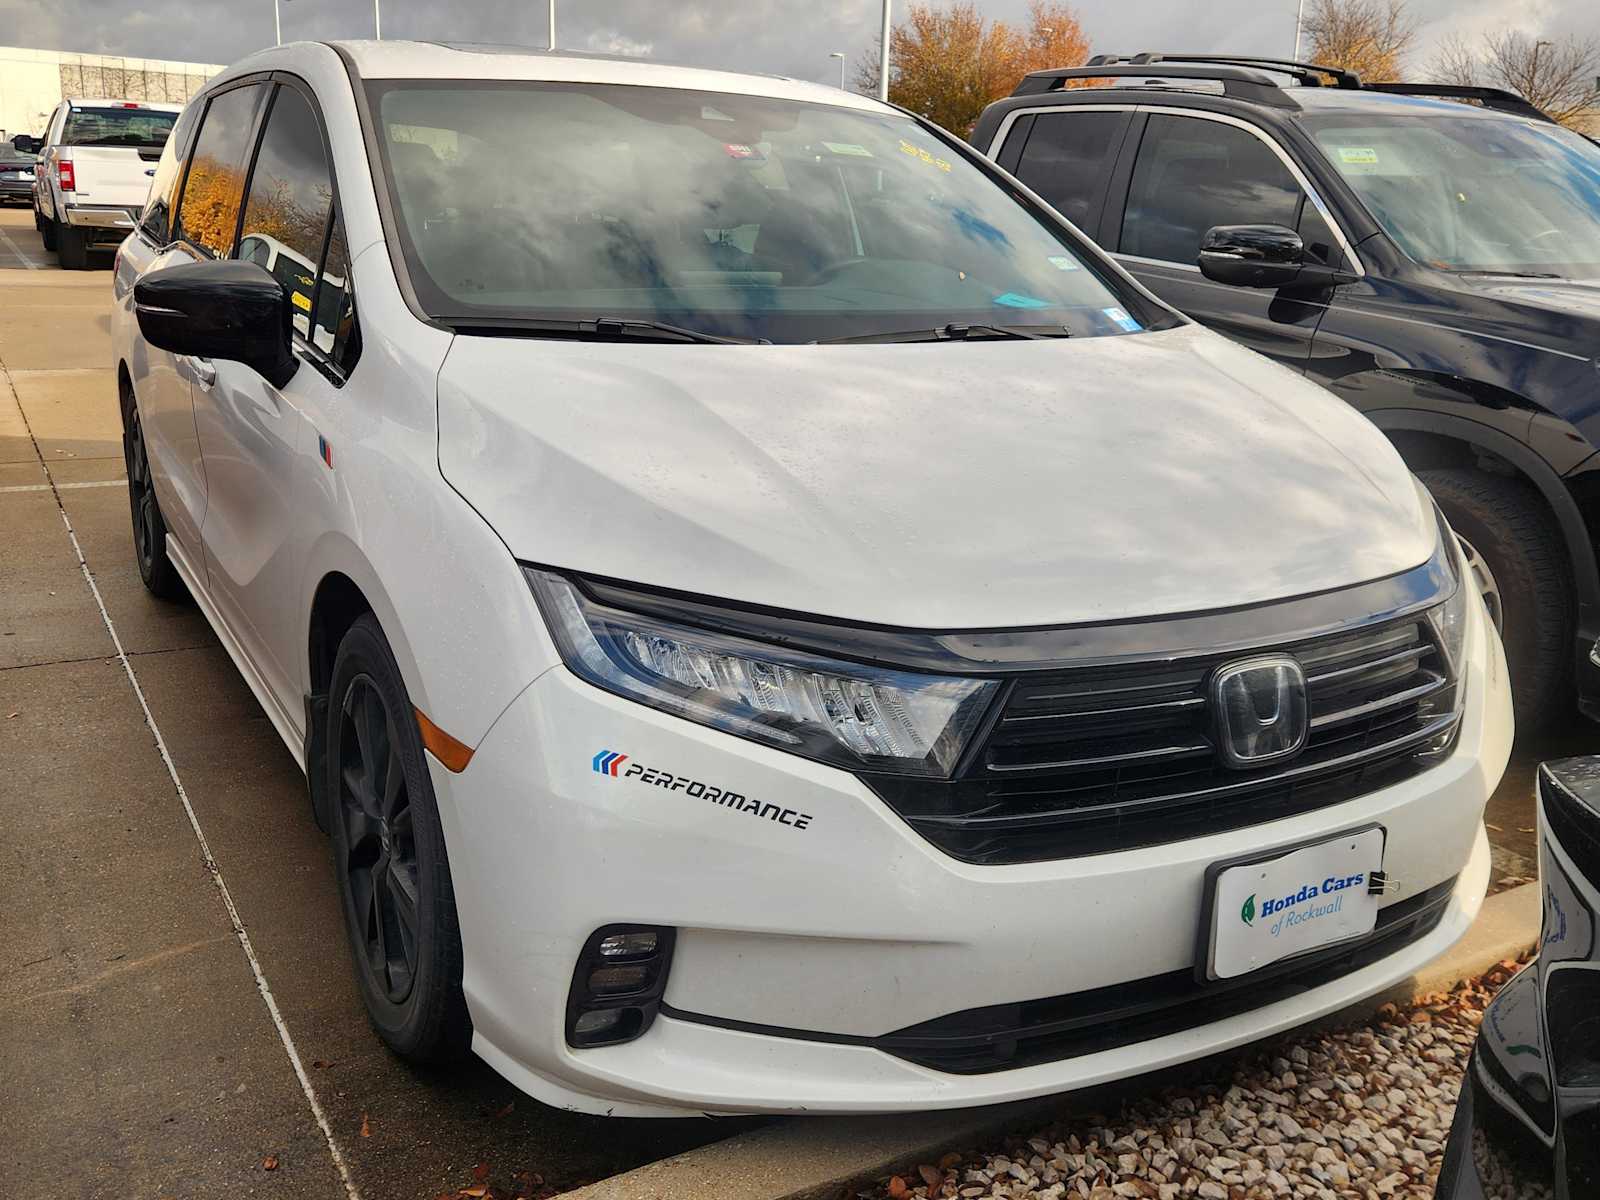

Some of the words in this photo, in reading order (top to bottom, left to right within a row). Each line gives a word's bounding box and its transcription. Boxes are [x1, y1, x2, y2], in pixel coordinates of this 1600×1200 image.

[625, 763, 813, 830] PERFORMANCE
[1261, 885, 1318, 917] Honda
[1322, 873, 1363, 893] Cars
[1271, 917, 1284, 936] of
[1287, 895, 1342, 927] Rockwall
